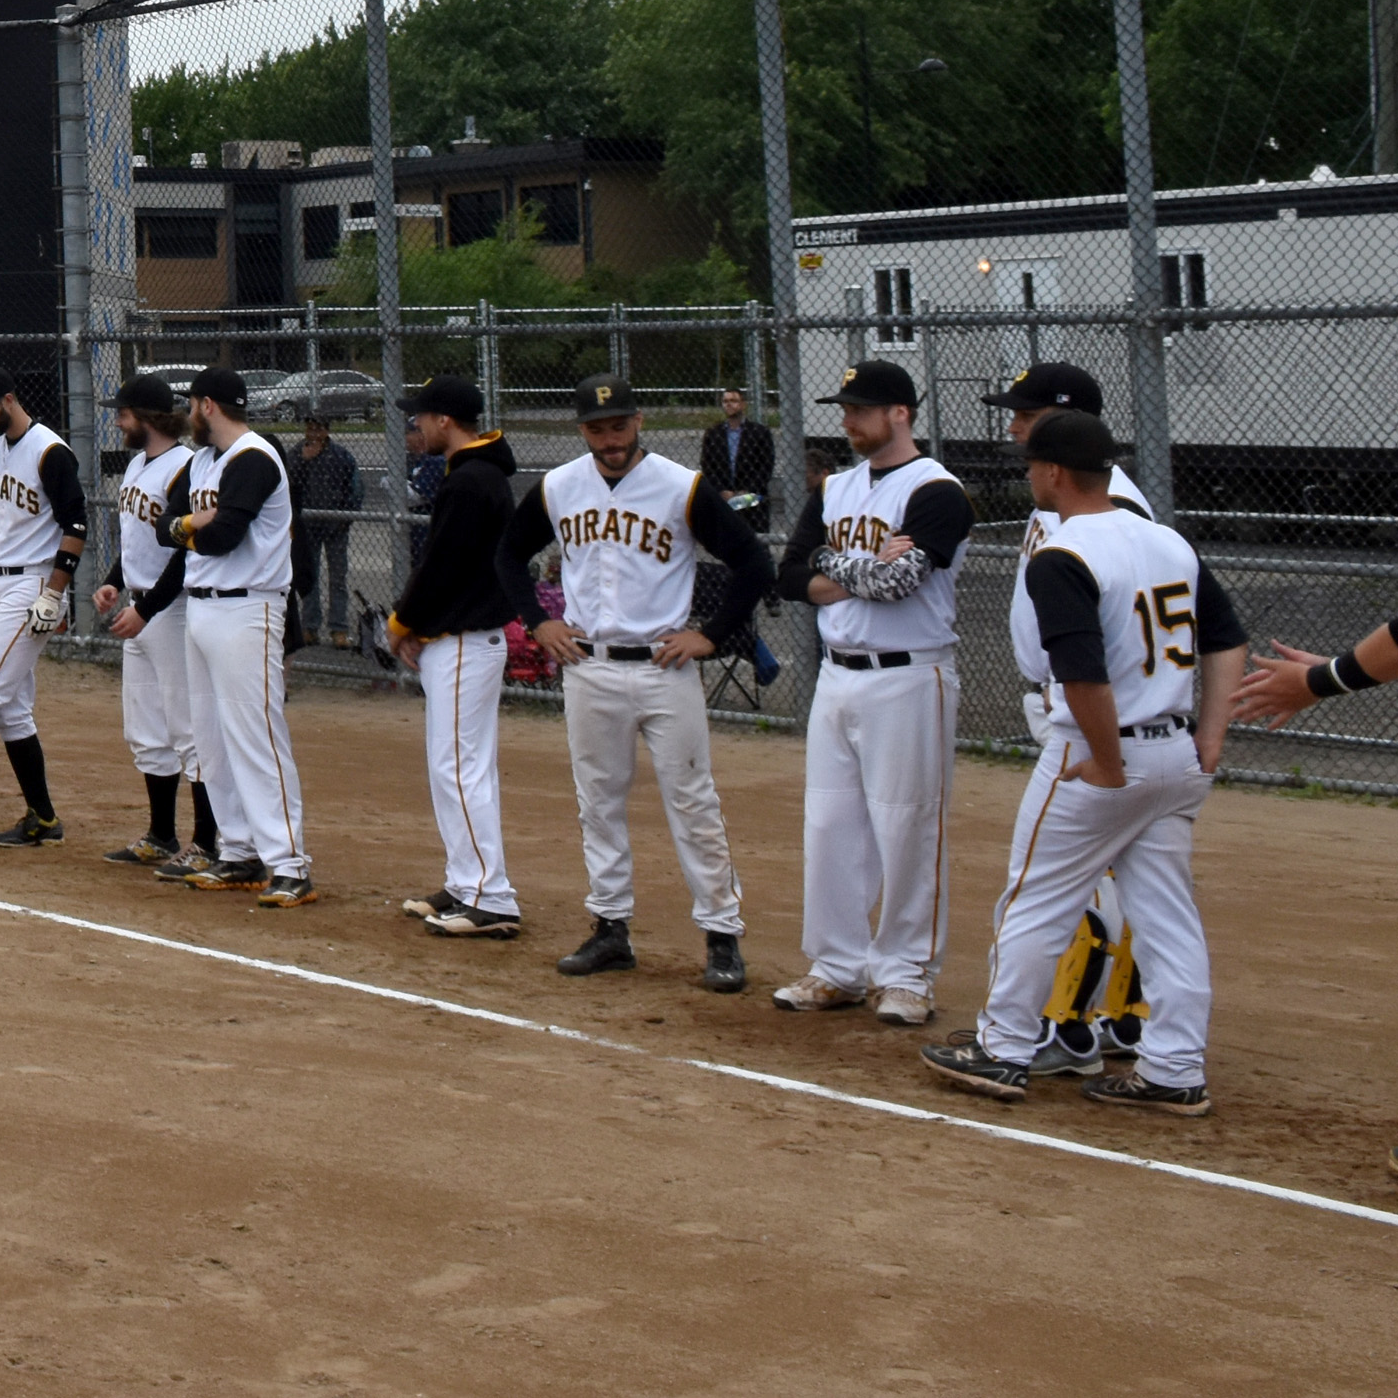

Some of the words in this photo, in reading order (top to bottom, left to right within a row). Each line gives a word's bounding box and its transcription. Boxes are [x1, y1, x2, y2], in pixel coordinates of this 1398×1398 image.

[794, 228, 858, 247] CLEMENT
[842, 368, 857, 387] P
[595, 386, 612, 406] P
[559, 507, 673, 563] PIRATES
[1133, 580, 1196, 679] 15
[1142, 723, 1171, 740] TPX
